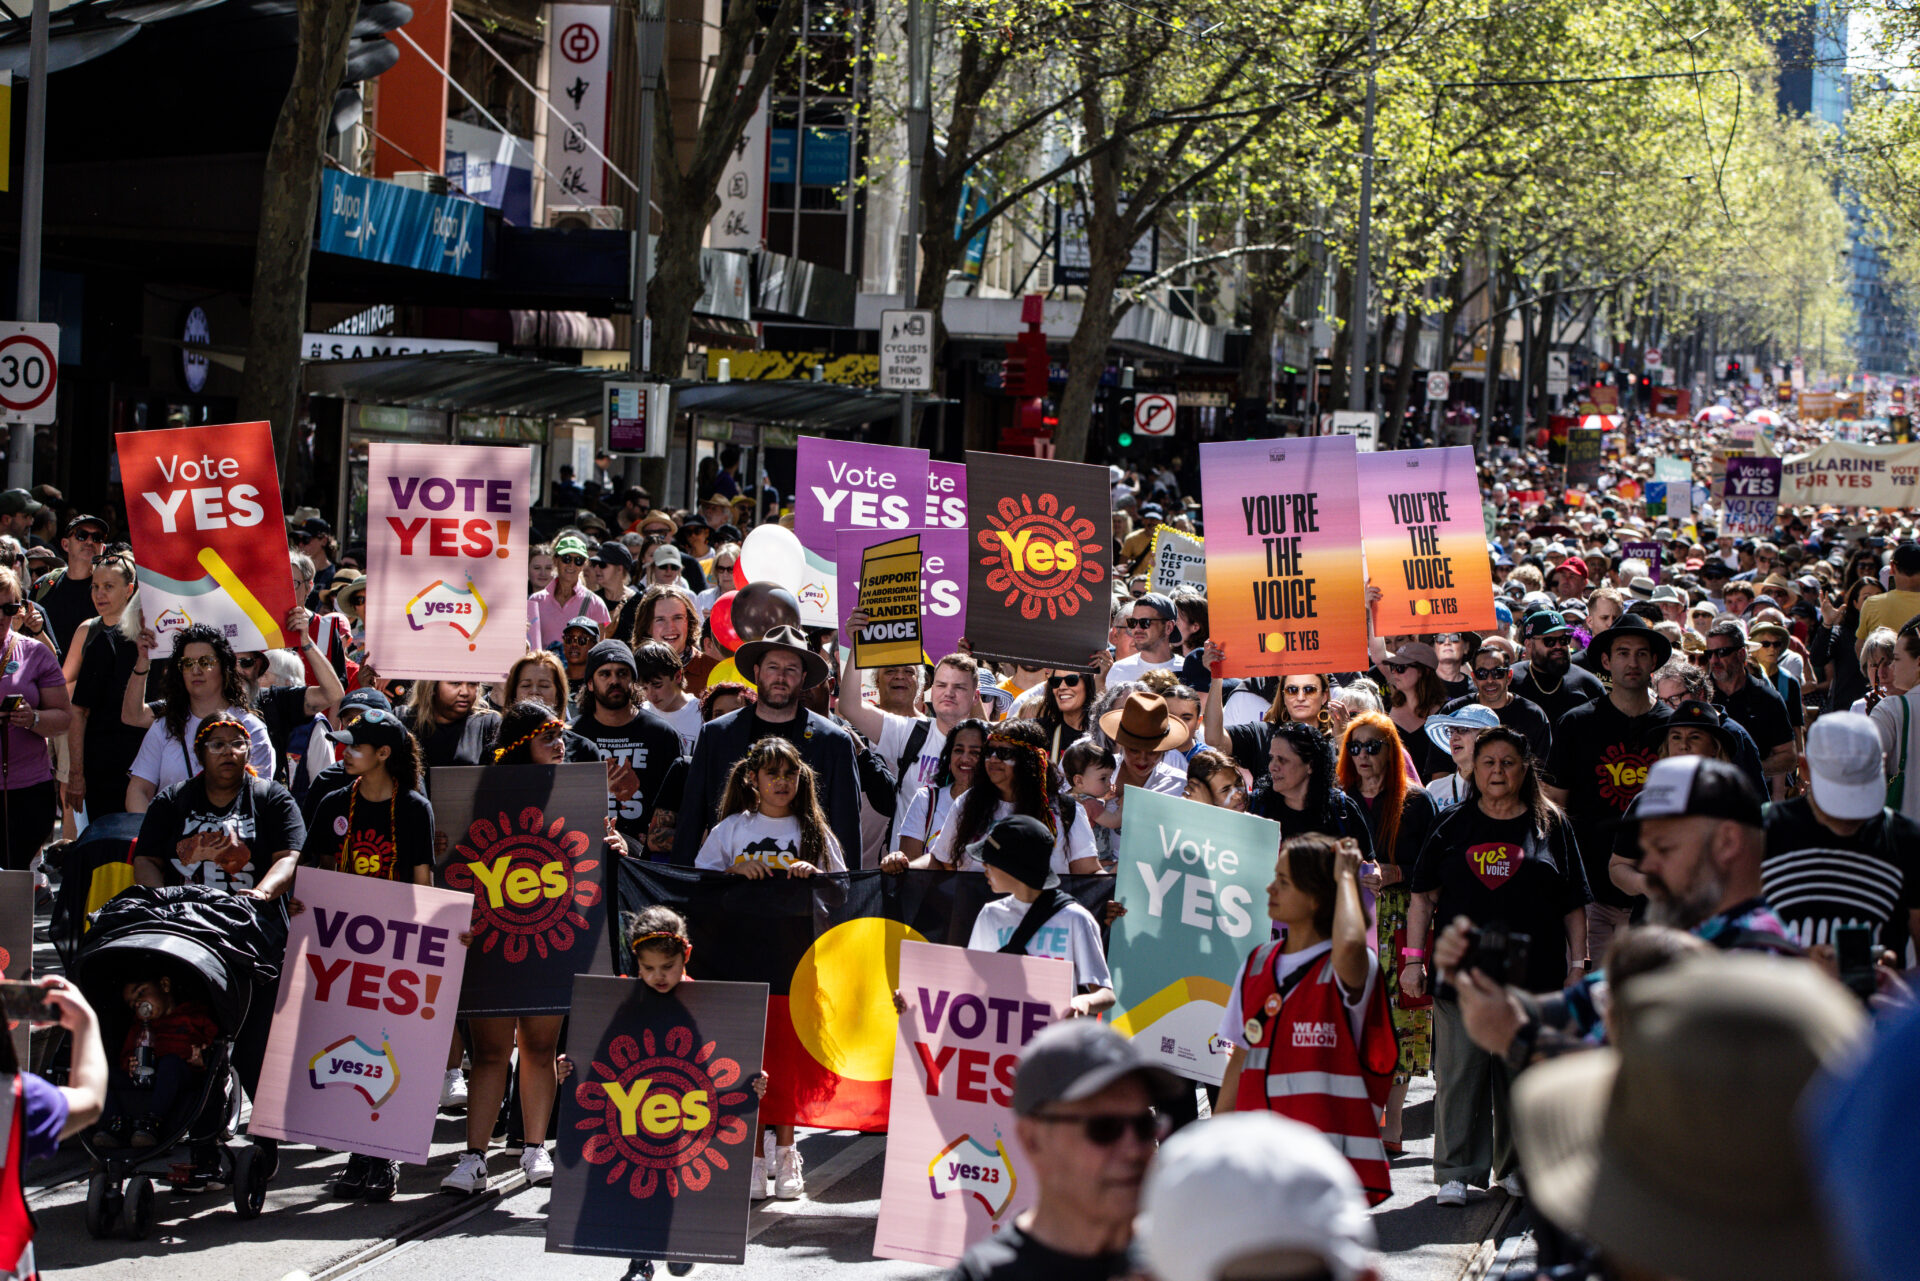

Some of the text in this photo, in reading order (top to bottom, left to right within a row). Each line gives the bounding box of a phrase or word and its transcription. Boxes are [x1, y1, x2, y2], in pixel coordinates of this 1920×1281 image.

[333, 184, 360, 224] Bupa
[433, 207, 459, 244] Bupa
[884, 344, 928, 353] CYCLISTS
[895, 355, 917, 364] STOP
[0, 355, 45, 388] 30
[888, 366, 922, 375] BEHIND
[890, 377, 921, 386] TRAMS
[155, 454, 240, 483] Vote
[828, 460, 897, 490] Vote
[1739, 465, 1770, 477] Vote
[1783, 458, 1886, 475] BELLARINE
[1891, 466, 1919, 475] VOTE
[927, 472, 956, 492] te
[1731, 478, 1774, 494] YES
[1795, 474, 1872, 490] FOR YES
[387, 476, 513, 513] VOTE
[141, 484, 264, 533] YES
[810, 486, 910, 529] YES
[925, 494, 967, 529] ES
[1241, 492, 1320, 536] YOU'RE
[1387, 491, 1451, 525] YOU'RE
[1725, 500, 1773, 513] VOICE
[1725, 513, 1775, 525] TREATY
[1729, 523, 1773, 533] TRUTH
[386, 516, 512, 559] YES!
[1163, 543, 1172, 552] A
[1407, 525, 1441, 556] THE
[996, 530, 1077, 572] Yes
[1262, 536, 1304, 577] THE
[1628, 548, 1657, 558] VOTE
[1159, 568, 1175, 578] TO
[1161, 560, 1181, 569] YES
[1403, 558, 1455, 590] VOICE
[863, 571, 918, 588] I SUPPORT
[1158, 577, 1181, 587] THE
[804, 591, 824, 599] yes23
[862, 586, 918, 598] AN ABORIGINAL
[866, 596, 892, 605] TORRES
[893, 594, 917, 602] STRAIT
[1253, 578, 1317, 620] VOICE
[424, 601, 472, 616] yes23
[863, 604, 918, 618] SLANDER
[1441, 598, 1458, 615] YES
[162, 617, 185, 626] yes23
[1549, 613, 1560, 624] LA
[862, 621, 917, 641] VOICE
[1298, 630, 1319, 651] YES
[599, 748, 649, 769] OTE
[1604, 761, 1648, 786] Yes
[608, 790, 643, 820] ES
[182, 817, 256, 838] VOTE
[1158, 824, 1239, 876] Vote
[1474, 846, 1507, 875] yes
[170, 858, 256, 892] YES
[1486, 865, 1510, 877] VOICE
[467, 855, 569, 909] Yes
[1136, 860, 1252, 939] YES
[313, 906, 449, 967] VOTE
[997, 926, 1069, 953] VTE
[306, 953, 443, 1020] YES!
[917, 987, 1051, 1047] VOTE
[1293, 1022, 1336, 1033] WE ARE
[1293, 1032, 1336, 1046] UNION
[329, 1057, 383, 1079] yes23
[914, 1041, 1020, 1108] YES
[601, 1078, 711, 1136] Yes
[948, 1161, 1000, 1184] yes23
